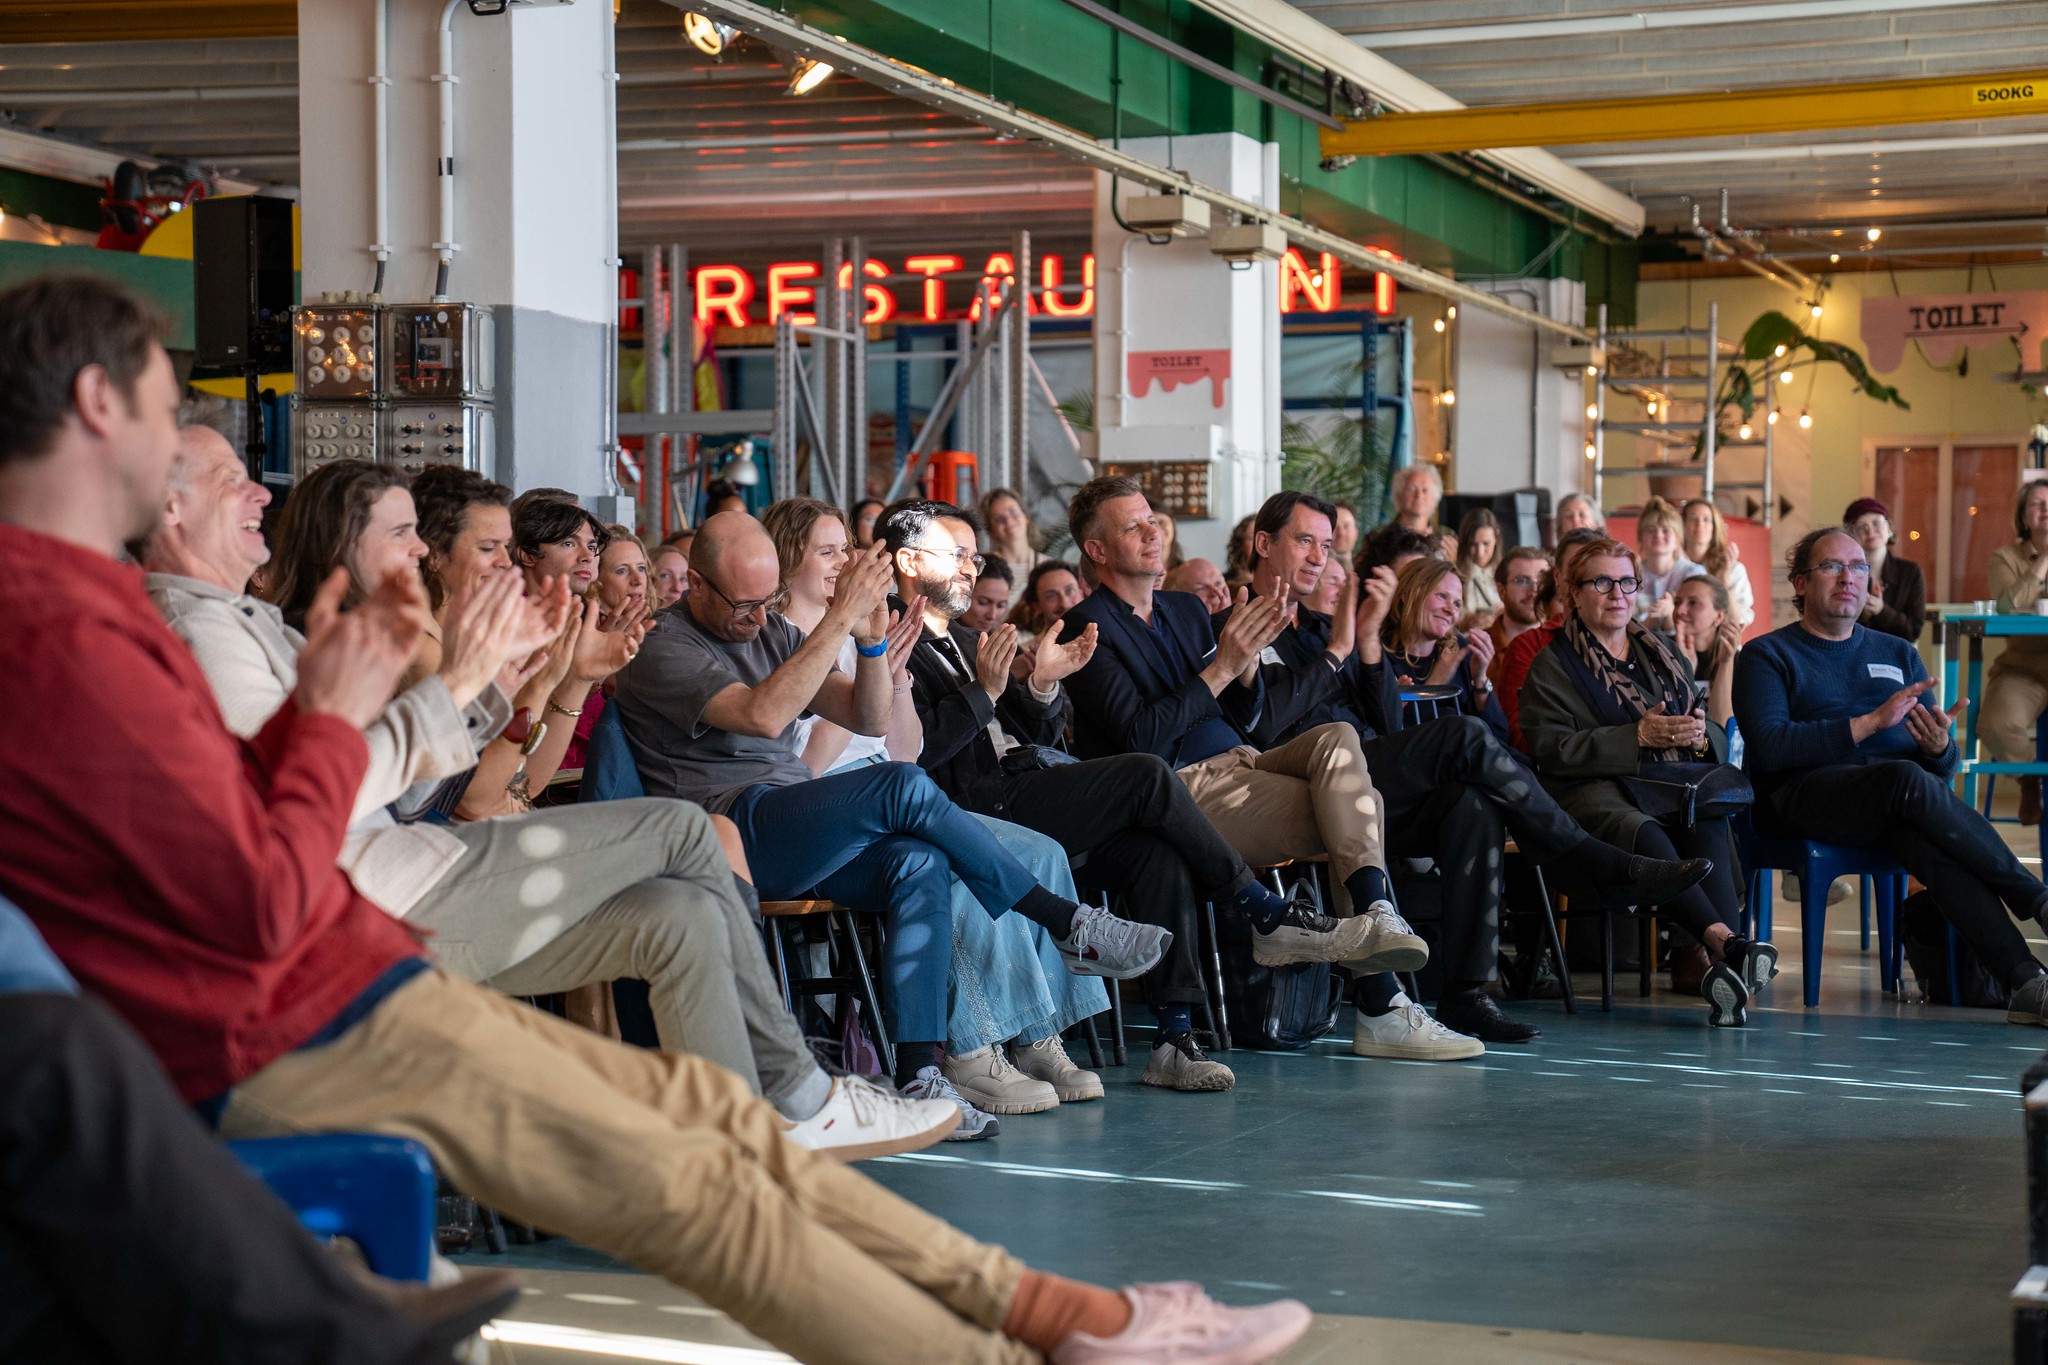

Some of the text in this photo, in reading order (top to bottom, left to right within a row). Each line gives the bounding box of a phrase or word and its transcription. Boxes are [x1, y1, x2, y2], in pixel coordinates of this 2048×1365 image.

[1977, 85, 2034, 102] 500KG
[694, 246, 1398, 328] RESTAUNT
[1909, 302, 2006, 330] TOILET
[1151, 355, 1203, 368] TOILET
